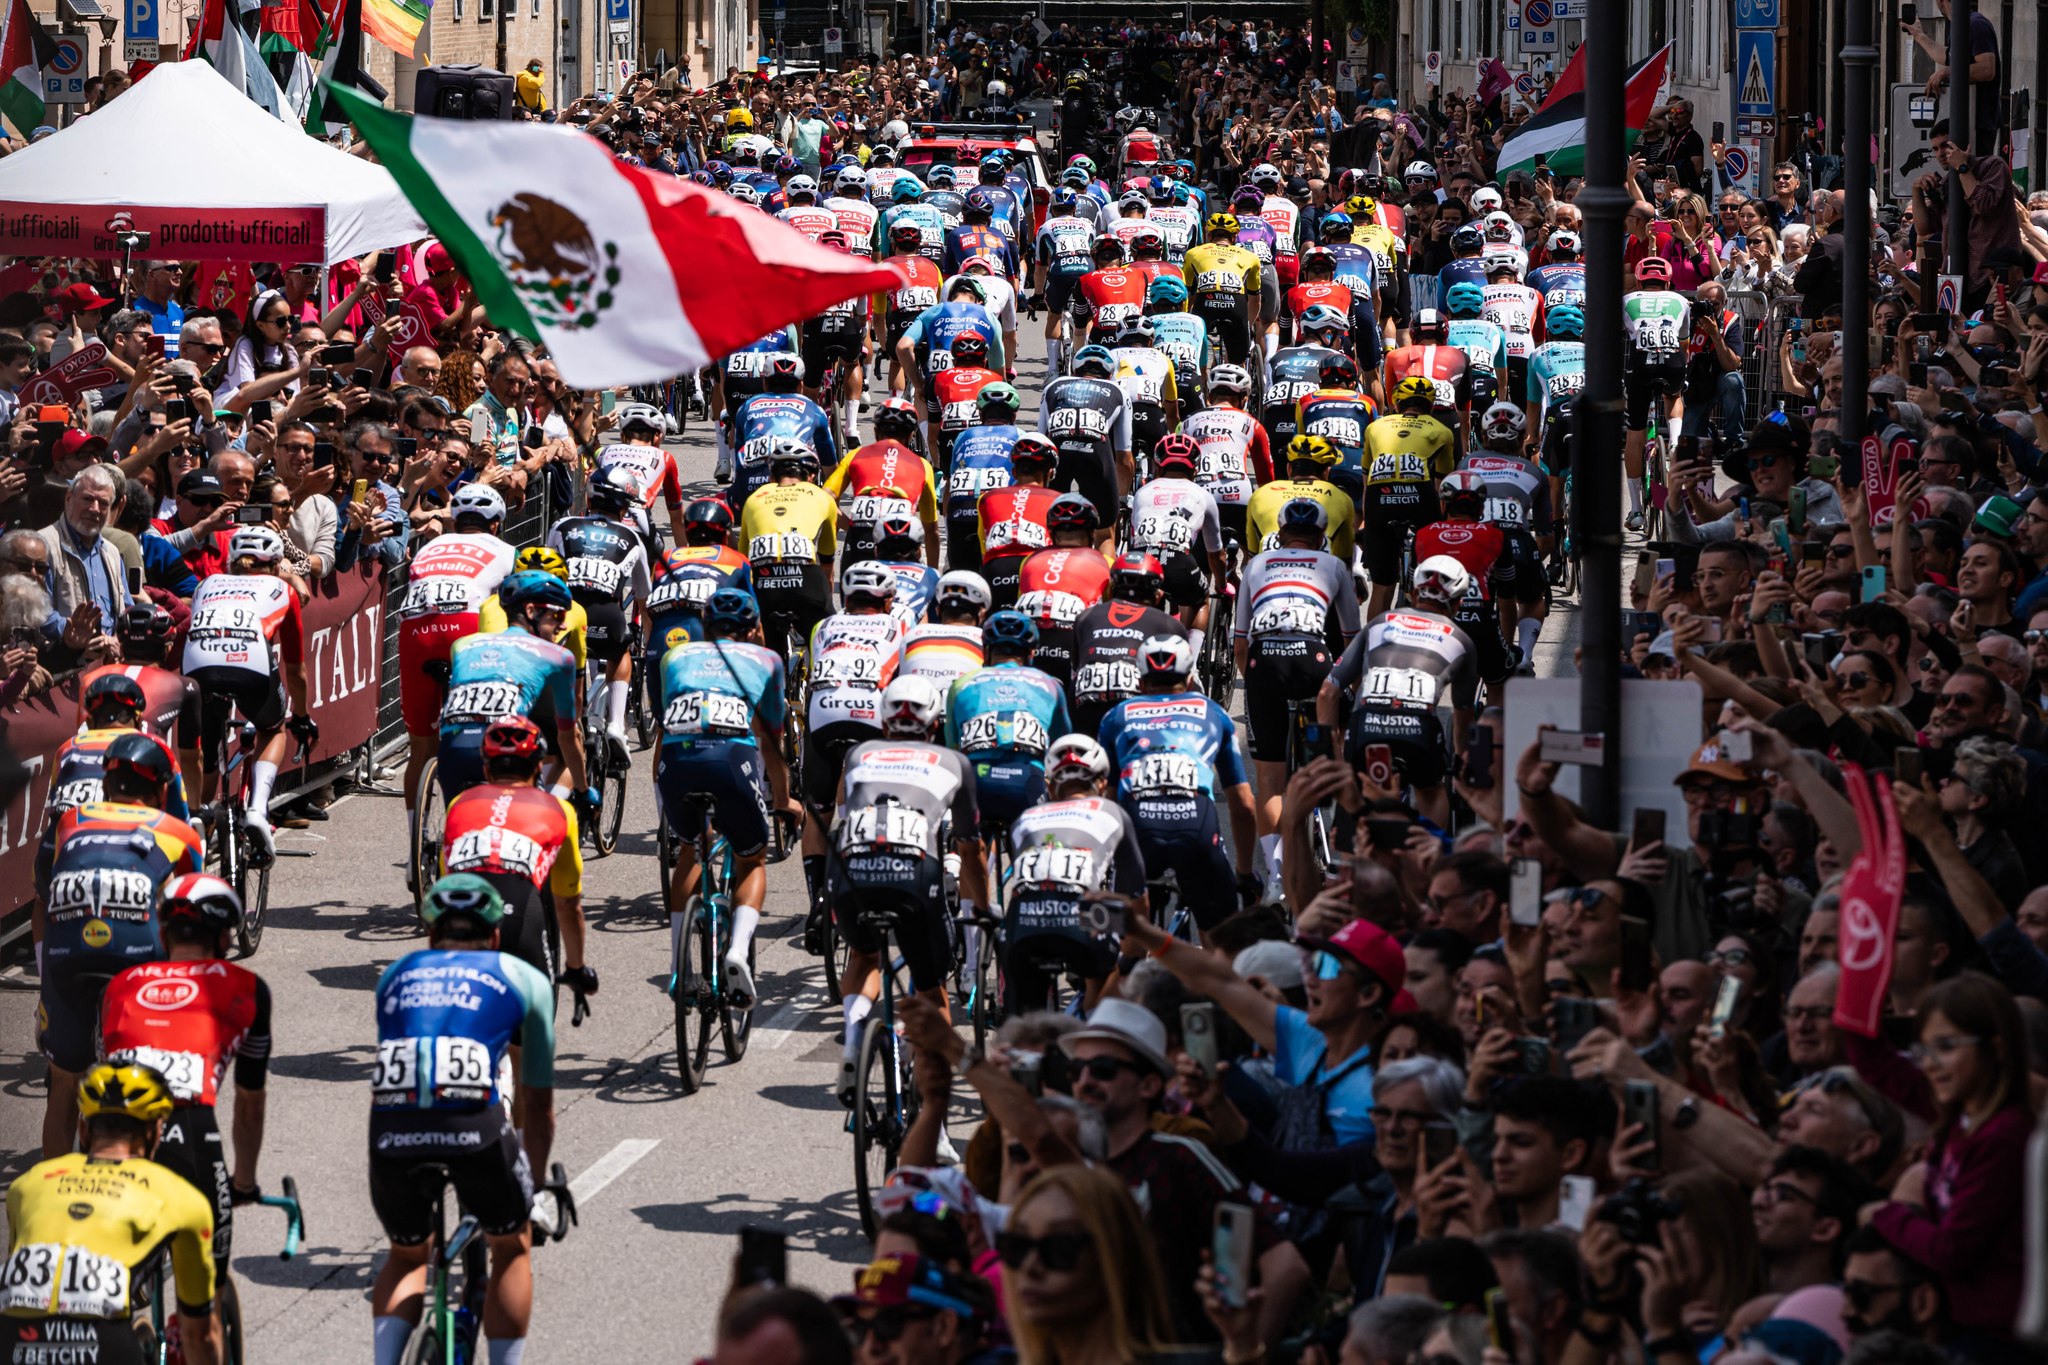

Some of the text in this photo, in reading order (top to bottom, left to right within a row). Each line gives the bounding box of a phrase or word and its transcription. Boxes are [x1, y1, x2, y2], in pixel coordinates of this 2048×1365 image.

[132, 0, 151, 33] P
[1557, 4, 1565, 14] P
[1510, 18, 1517, 26] P
[1526, 33, 1533, 42] P
[51, 80, 59, 90] P
[794, 215, 830, 223] POLTI
[10, 214, 80, 240] ufficiali
[160, 220, 311, 246] prodotti ufficiali
[1061, 257, 1089, 266] BORA
[1092, 268, 1133, 276] ARKEA
[1198, 271, 1242, 287] 185 185
[900, 290, 915, 305] 45
[1545, 292, 1564, 307] 143
[1101, 306, 1115, 320] 28
[1640, 300, 1671, 313] EF
[945, 317, 991, 330] DECATHLON
[1640, 329, 1674, 347] 66 66
[57, 348, 99, 376] TOYOTA
[733, 355, 748, 370] 51
[932, 353, 948, 370] 56
[1076, 383, 1111, 397] UBS
[1144, 380, 1157, 396] 81
[752, 401, 804, 412] SOUDAL
[947, 403, 959, 418] 21
[1308, 402, 1365, 412] TREK
[1050, 412, 1073, 429] 136
[746, 439, 767, 460] 148
[964, 449, 1009, 458] MONDIALE
[965, 444, 988, 452] AG2R
[880, 448, 898, 488] Cofidis
[1221, 453, 1240, 470] 96
[1372, 454, 1424, 473] 184 184
[1475, 460, 1518, 470] Alpecin
[1866, 445, 1879, 496] TOYOTA
[952, 471, 1004, 489] 57 57
[1293, 487, 1332, 496] VISMA
[1012, 489, 1031, 519] Cofidis
[1386, 495, 1420, 504] BETCITY
[856, 500, 875, 519] 46
[1500, 503, 1517, 520] 18
[992, 523, 1043, 540] 48 48
[1138, 518, 1187, 544] 63 63
[1429, 522, 1487, 530] ARKEA
[590, 532, 629, 550] UBS
[751, 536, 810, 558] 181 181
[417, 545, 485, 560] POLTI
[410, 562, 475, 575] VisitMalta
[773, 566, 802, 575] VISMA
[1044, 551, 1070, 584] Cofidis
[1265, 560, 1315, 573] SOUDAL
[763, 579, 803, 588] BETCITY
[433, 583, 465, 601] 175
[1018, 594, 1036, 615] 44
[194, 609, 255, 628] 97 97
[1394, 615, 1446, 633] Alpecin
[231, 631, 255, 639] TUDOR
[412, 623, 460, 635] AURUM
[1093, 628, 1144, 641] TUDOR
[1384, 624, 1444, 643] deceuninck
[200, 639, 248, 652] Circus
[1096, 647, 1128, 656] TUDOR
[1263, 641, 1306, 649] RENSON
[814, 659, 876, 678] 92 92
[920, 669, 956, 678] TUDOR
[1077, 665, 1104, 692] 195
[1371, 673, 1423, 699] 11 11
[447, 687, 516, 714] 227 227
[819, 696, 875, 709] Circus
[667, 697, 745, 726] 225 225
[1127, 706, 1203, 717] SOUDAL
[1365, 713, 1420, 726] BRUSTOR
[962, 716, 996, 744] 226
[1364, 726, 1422, 735] SUN SYSTEMS
[1133, 759, 1162, 787] 147
[490, 795, 513, 826] Cofidis
[1140, 801, 1196, 812] RENSON
[1139, 811, 1197, 820] OUTDOOR
[846, 814, 920, 843] 14 14
[459, 836, 533, 860] 41 41
[893, 846, 921, 855] TUDOR
[850, 857, 915, 871] BRUSTOR
[1018, 854, 1086, 881] 17 17
[871, 872, 915, 881] SYSTEMS
[52, 874, 148, 907] 118 118
[55, 909, 144, 921] TUDOR TUDOR
[1020, 901, 1080, 914] BRUSTOR
[1020, 917, 1037, 925] SUN
[127, 963, 227, 980] ARKEA
[402, 966, 507, 994] DECATHLON
[146, 987, 189, 998] B&B
[401, 982, 471, 994] AG2R LA
[400, 994, 483, 1011] MONDIALE
[161, 1056, 192, 1083] 23
[449, 1045, 481, 1081] 55
[394, 1131, 481, 1146] DECATHLON
[63, 1253, 122, 1297] 183
[45, 1320, 98, 1341] VISMA
[26, 1344, 99, 1364] BETCITY
